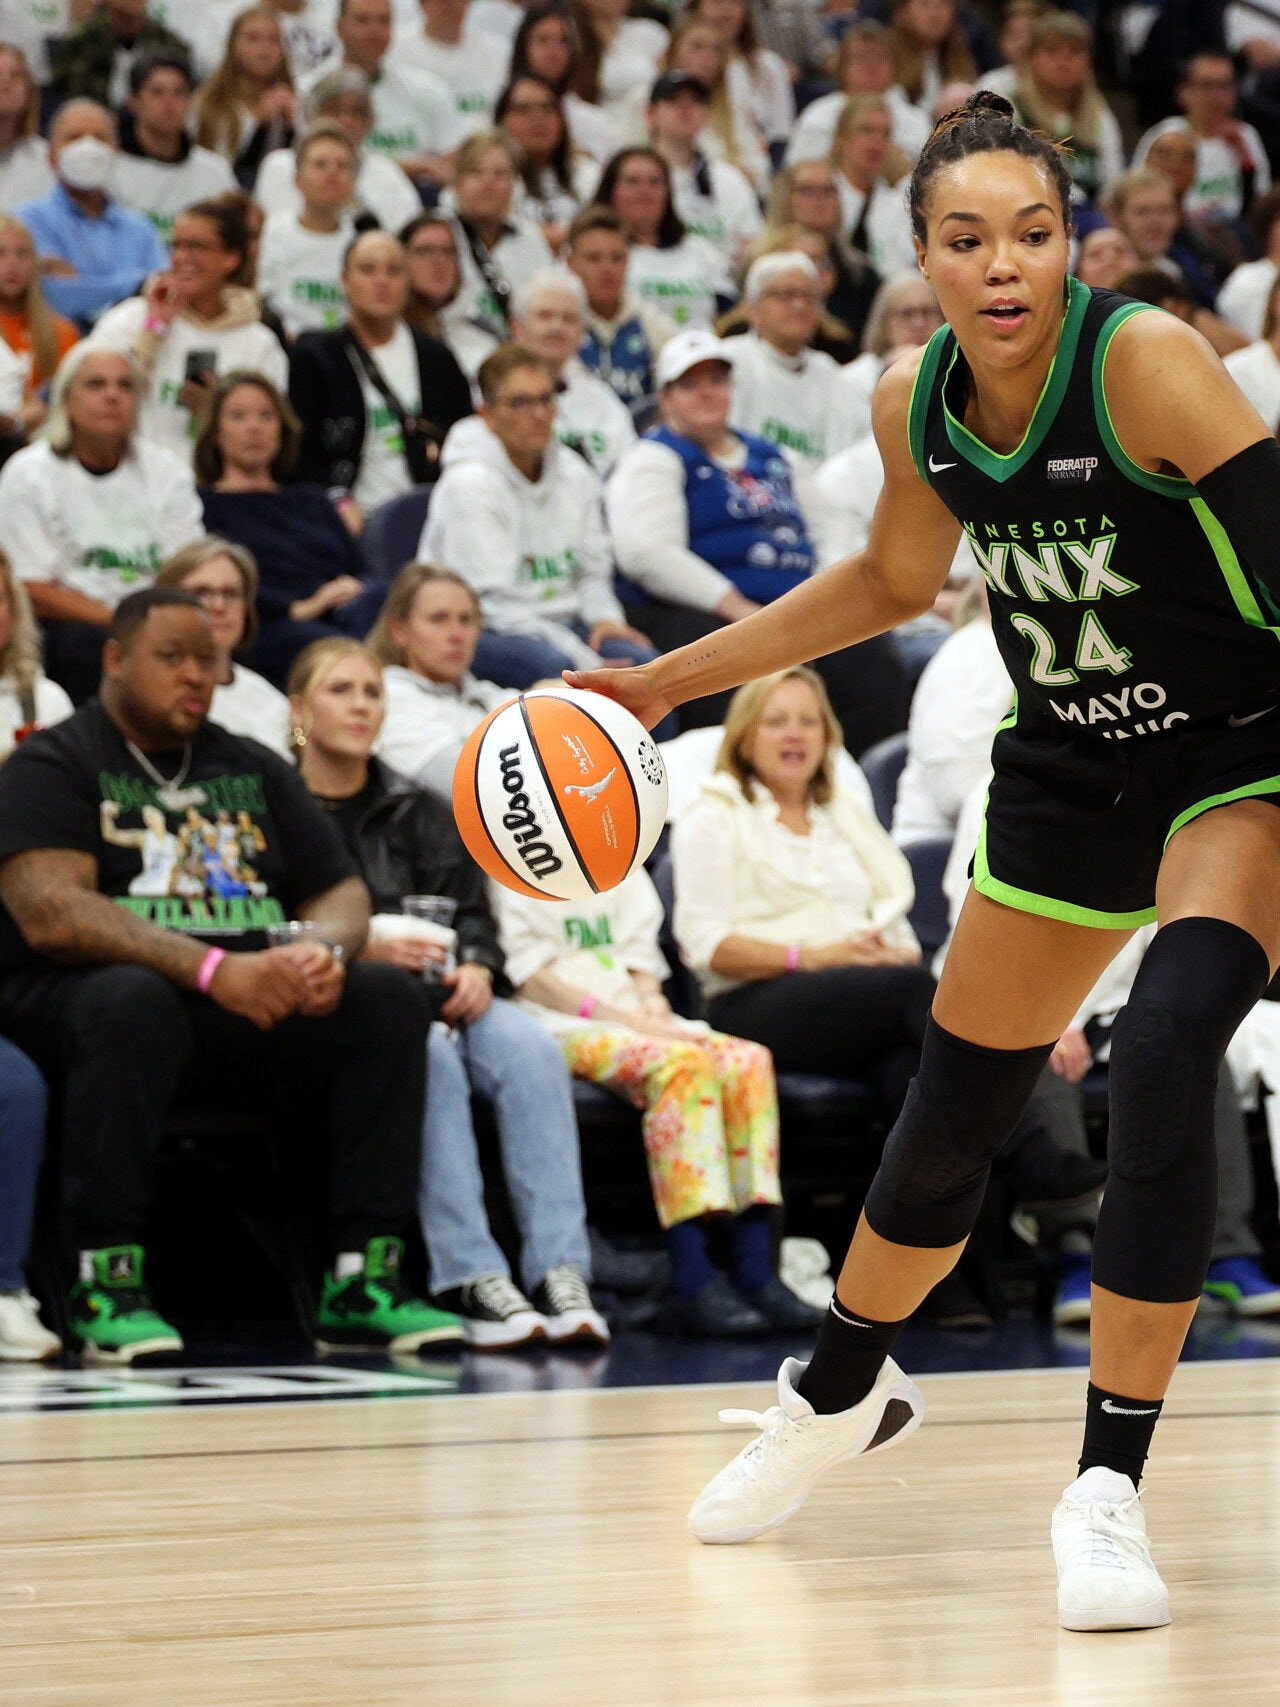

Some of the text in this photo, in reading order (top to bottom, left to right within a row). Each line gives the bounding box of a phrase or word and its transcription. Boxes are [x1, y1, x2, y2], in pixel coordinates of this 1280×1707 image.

[1047, 457, 1098, 471] FEDERATED
[1047, 470, 1083, 480] INSURANCE
[963, 514, 1115, 539] NNESOTA
[967, 533, 1141, 602] YNX
[1010, 609, 1133, 686] 24
[1049, 682, 1167, 725] MAYO
[499, 741, 563, 881] Wilson
